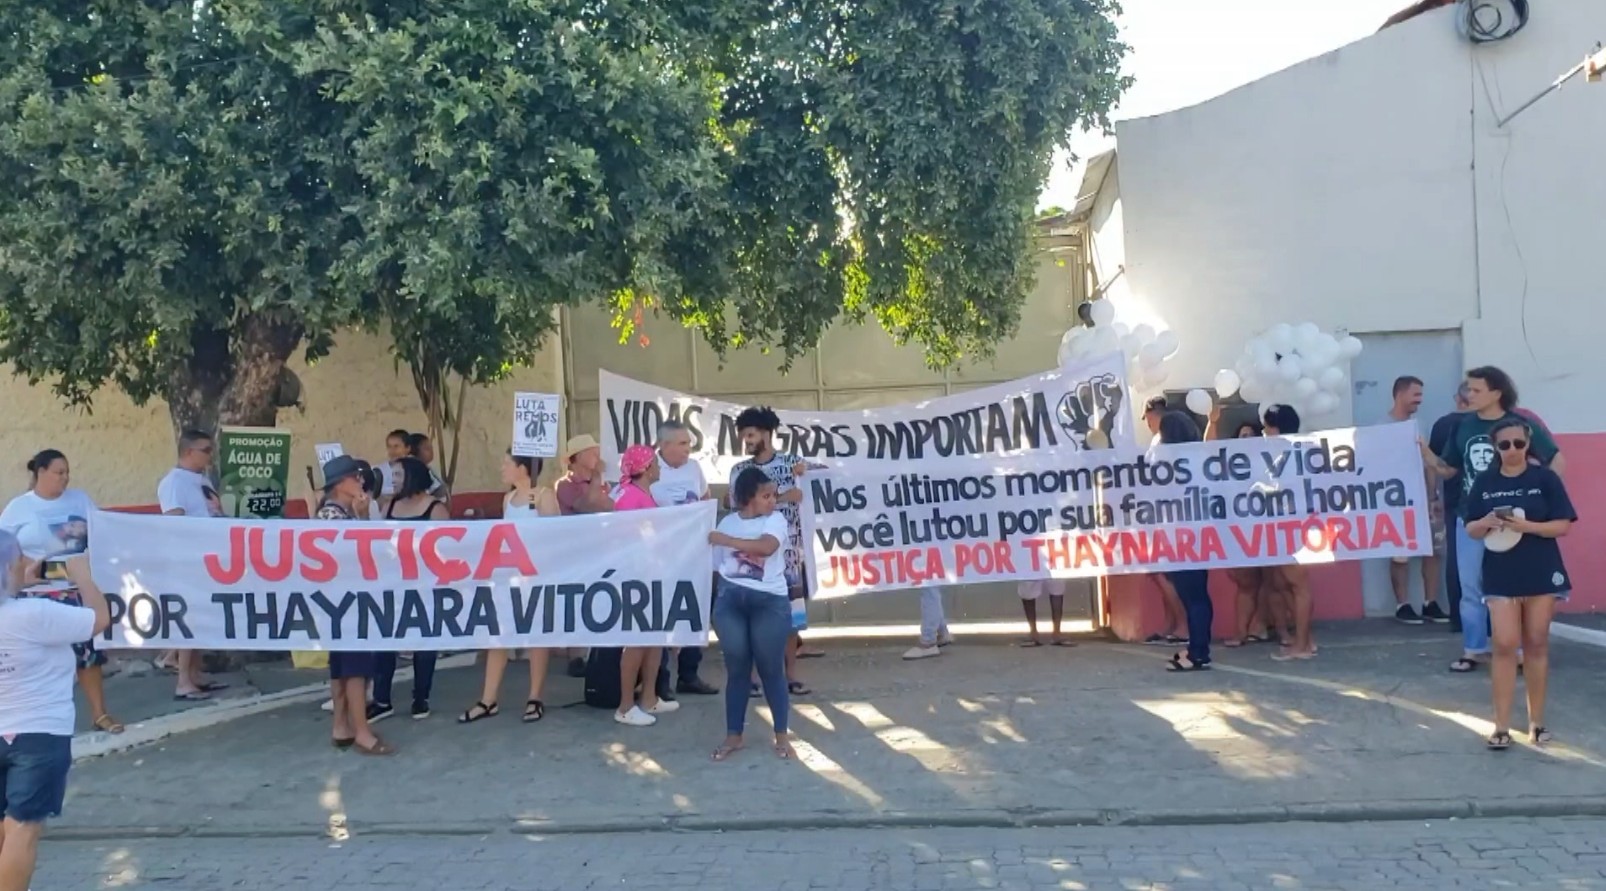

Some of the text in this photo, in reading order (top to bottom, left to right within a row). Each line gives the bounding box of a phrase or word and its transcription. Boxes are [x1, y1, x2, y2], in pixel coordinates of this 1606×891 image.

[515, 399, 545, 410] LUTA
[718, 413, 858, 458] NGRAS
[862, 392, 1058, 460] IMPORTAM
[228, 449, 282, 465] ÁGUA DE
[229, 437, 283, 448] PROMOÇÃO
[239, 466, 273, 478] COCO
[811, 438, 1364, 514] Nos últimos momentos de vida,
[816, 478, 1414, 552] você lutou por sua família com honra.
[204, 522, 538, 585] JUSTIÇA
[821, 509, 1418, 588] JUSTIÇA POR THAYNARA VITÓRIA!
[103, 569, 702, 640] POR THAYNARA VITÓRIA
